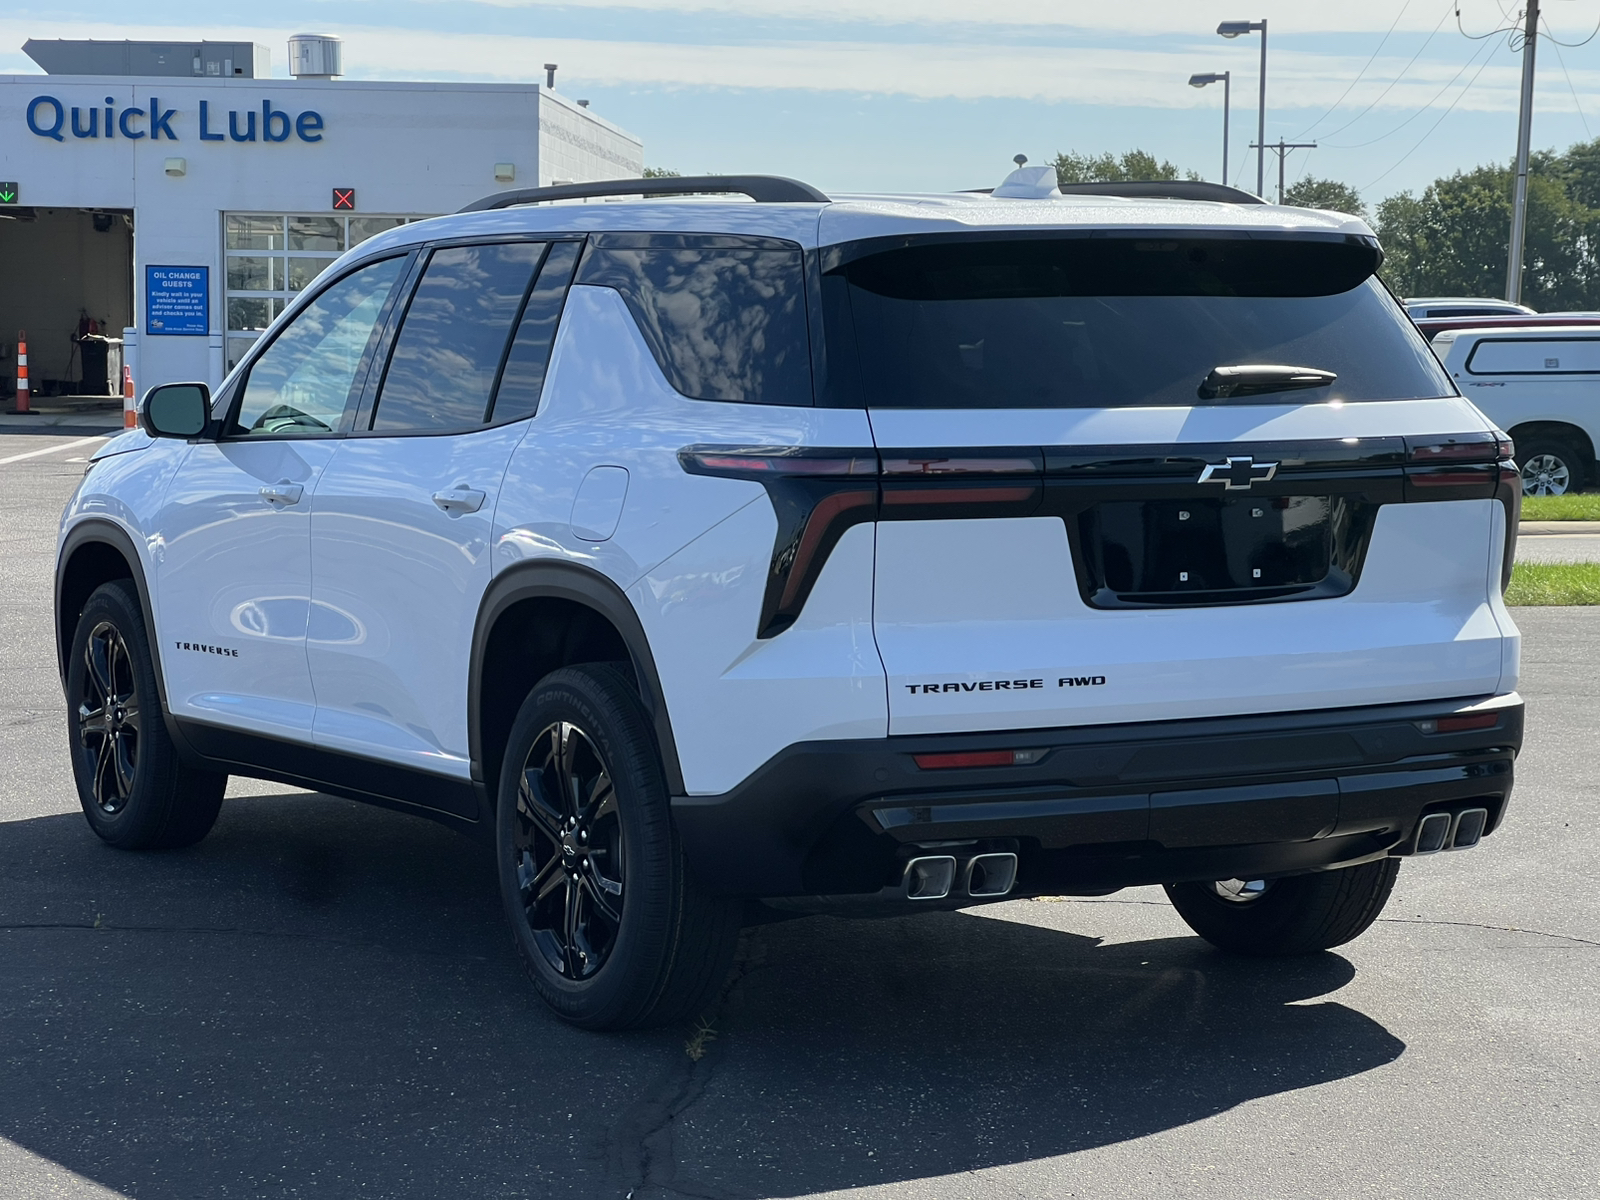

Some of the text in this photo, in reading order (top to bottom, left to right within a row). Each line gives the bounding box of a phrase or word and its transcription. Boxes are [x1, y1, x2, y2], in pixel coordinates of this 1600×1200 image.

[26, 95, 324, 142] Quick Lube
[174, 641, 239, 658] TRAVERSE
[905, 675, 1106, 694] TRAVERSE AWD
[536, 690, 614, 768] CONTINENTAL
